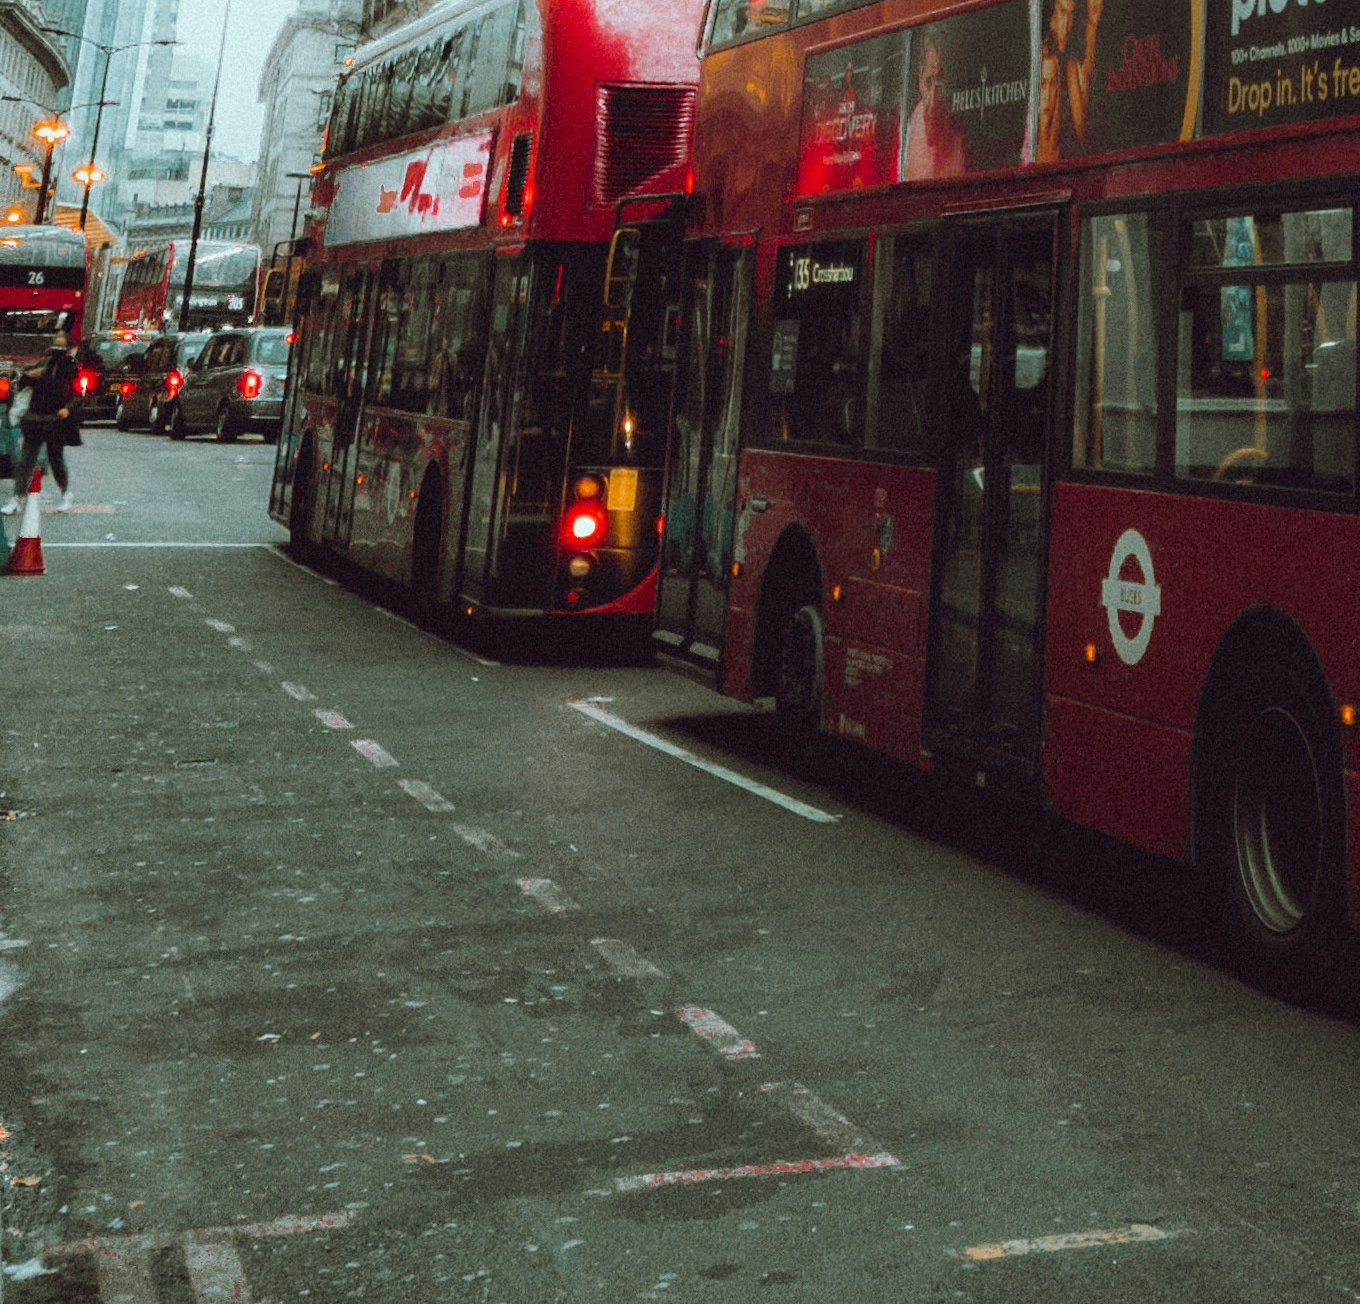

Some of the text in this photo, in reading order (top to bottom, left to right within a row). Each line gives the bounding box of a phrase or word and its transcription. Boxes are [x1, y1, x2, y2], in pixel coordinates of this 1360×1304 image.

[1311, 31, 1339, 50] Movies
[1341, 27, 1348, 44] &
[984, 79, 1028, 107] KITCHEN
[1229, 76, 1272, 117] Drop
[1276, 68, 1297, 106] in.
[1301, 61, 1328, 103] It's
[28, 271, 45, 285] 26
